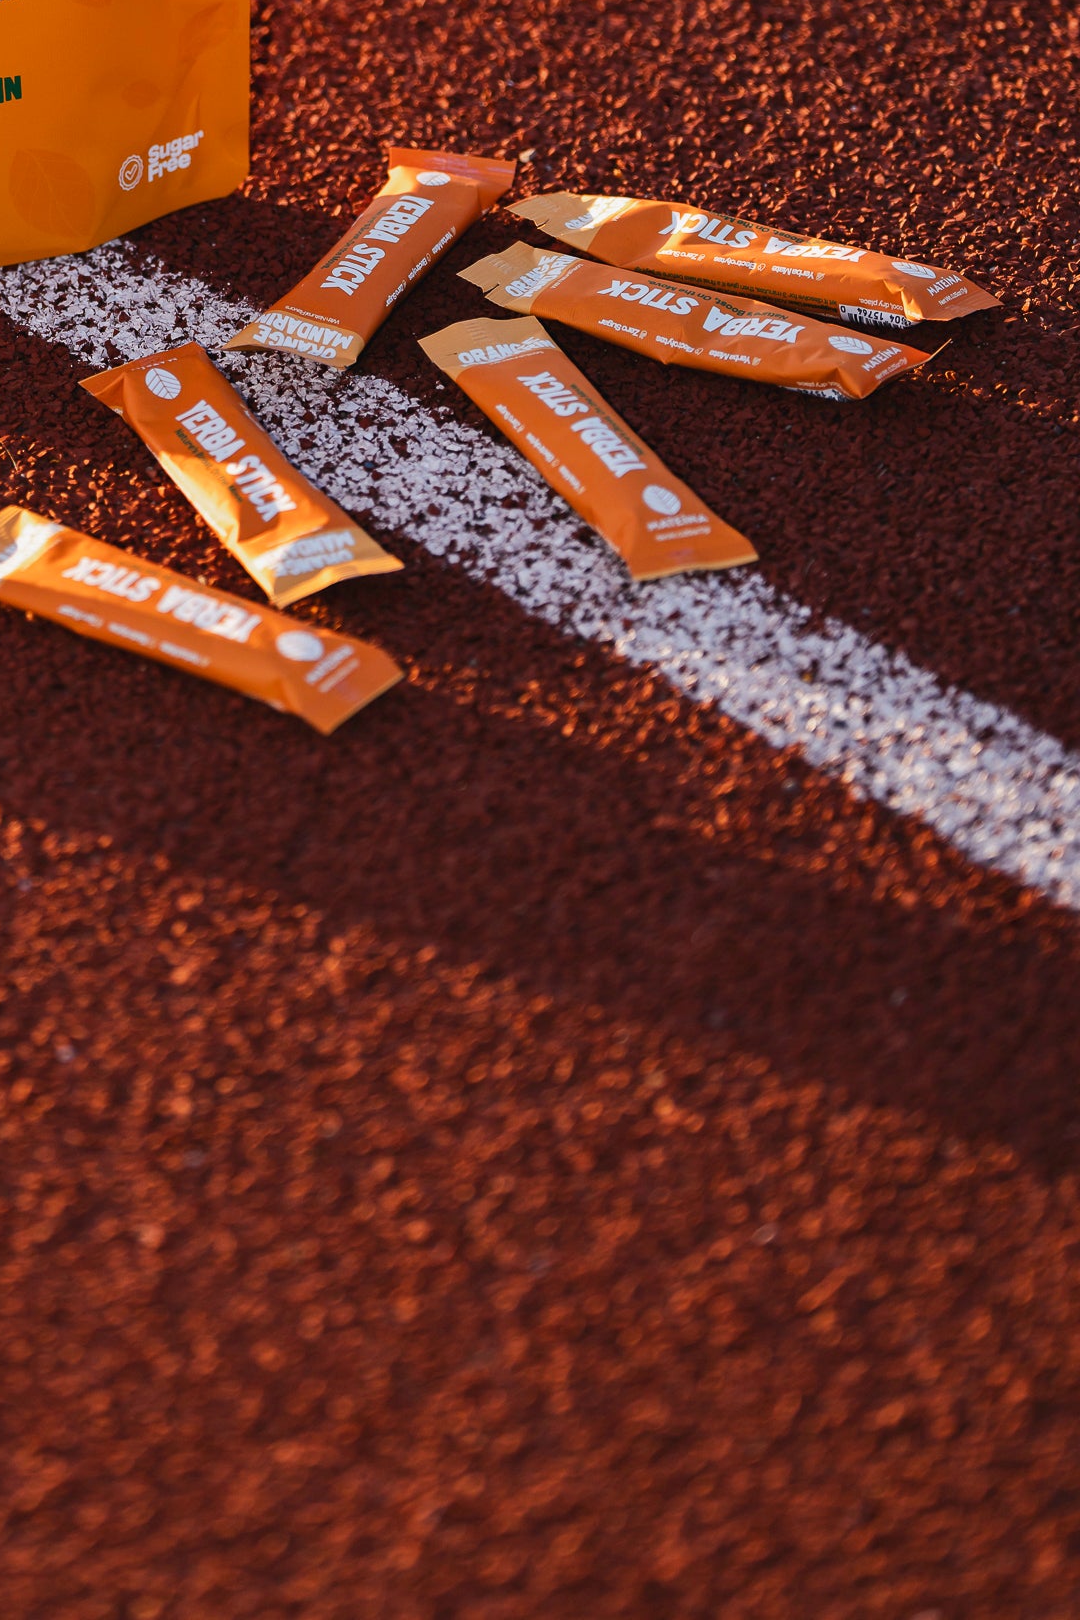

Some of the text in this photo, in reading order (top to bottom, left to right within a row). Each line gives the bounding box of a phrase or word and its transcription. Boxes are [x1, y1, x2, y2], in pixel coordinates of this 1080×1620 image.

[148, 129, 204, 164] Sugar
[148, 153, 192, 182] Free
[362, 195, 435, 244] YERBA
[658, 211, 869, 263] YERBA STICK
[320, 242, 386, 296] STICK
[597, 279, 699, 315] STICK
[677, 287, 697, 297] the
[697, 292, 712, 301] On
[713, 298, 746, 316] Boost,
[878, 299, 890, 309] dry
[703, 305, 806, 344] YERBA
[855, 306, 884, 320] 15764
[252, 325, 338, 359] ORANGE
[516, 371, 589, 417] STICK
[175, 399, 297, 523] YERBA STICK
[571, 417, 648, 478] YERBA
[61, 556, 162, 602] STICK
[155, 584, 263, 643] YERBA
